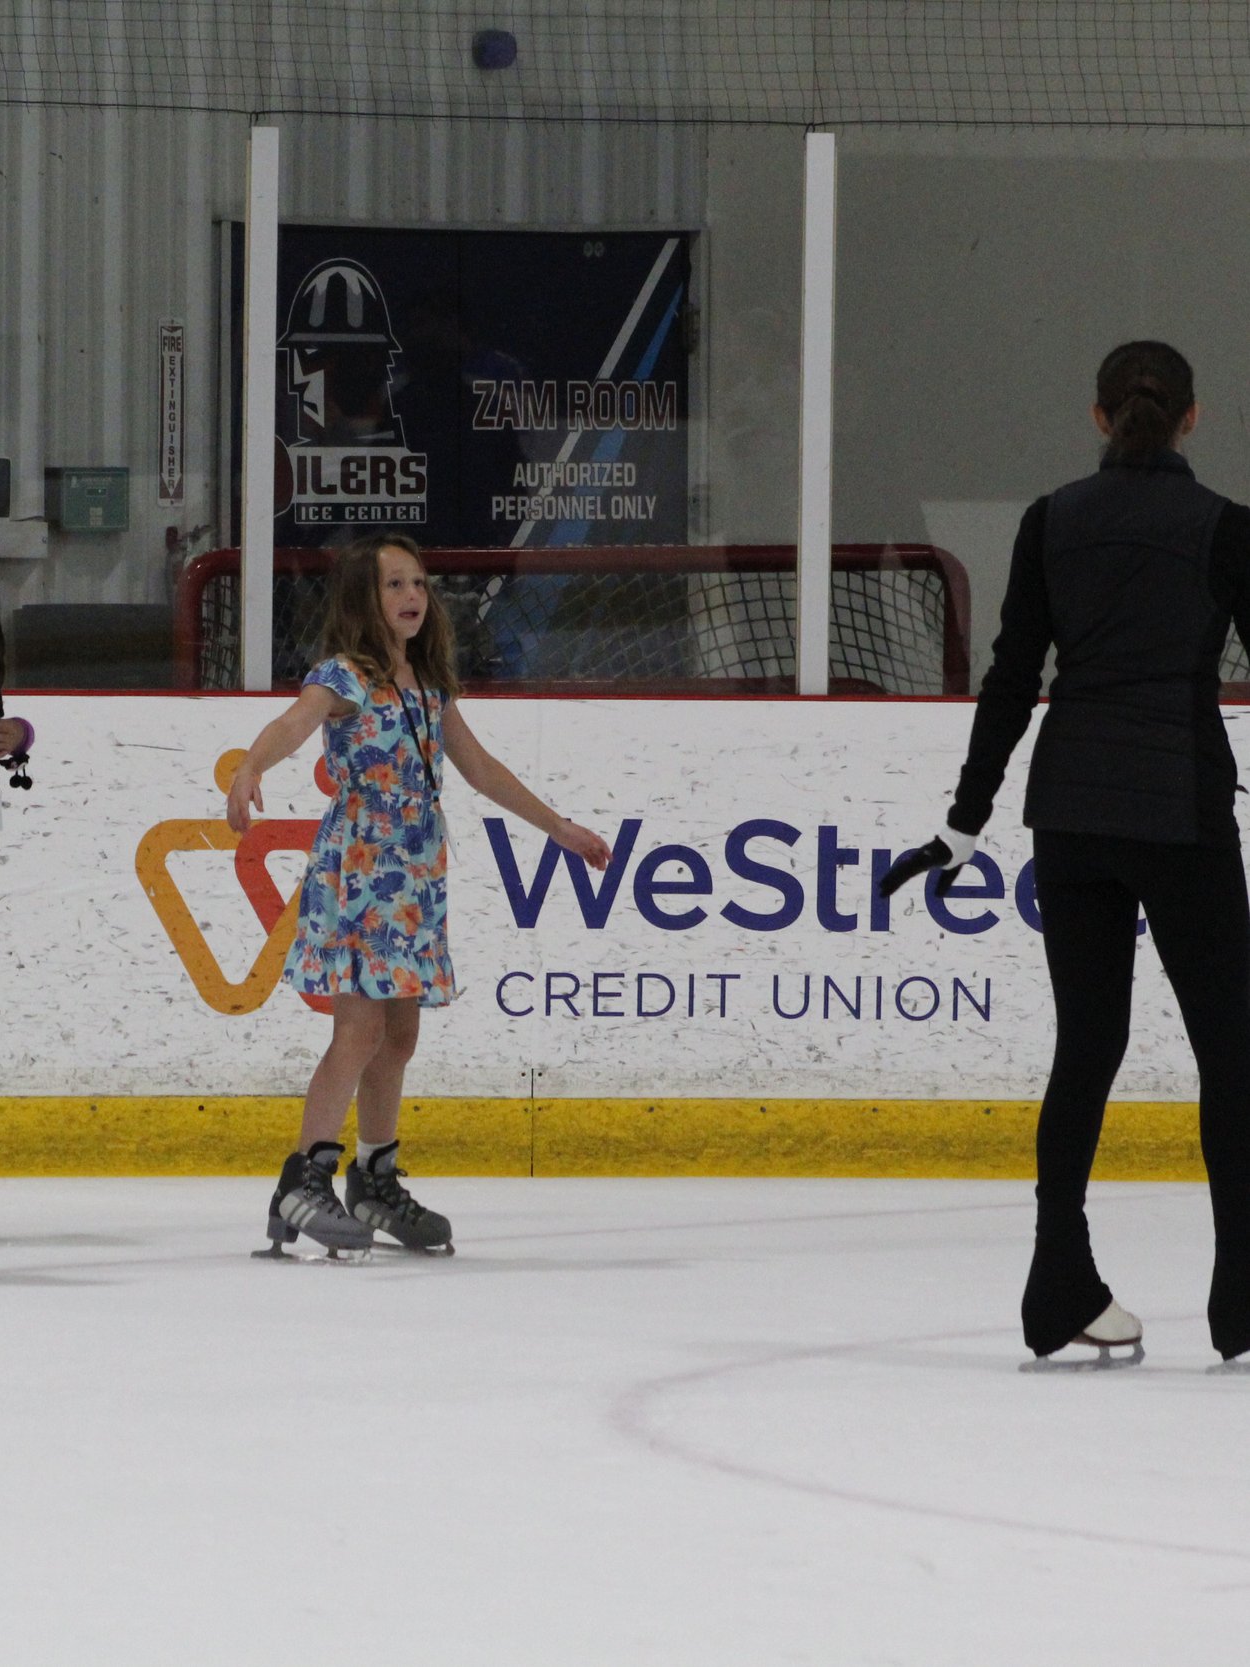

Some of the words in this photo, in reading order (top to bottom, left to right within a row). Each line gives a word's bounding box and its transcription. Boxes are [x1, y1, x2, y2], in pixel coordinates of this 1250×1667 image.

[162, 335, 182, 352] FIRE
[167, 355, 177, 489] EXTINGUISHER
[472, 380, 557, 430] ZAM
[567, 381, 677, 431] ROOM
[513, 462, 636, 488] AUTHORIZED
[300, 506, 333, 521] ICE
[344, 505, 421, 521] CENTER
[491, 496, 606, 520] PERSONNEL
[611, 496, 657, 520] ONLY
[482, 817, 1146, 936] WeStre
[495, 971, 741, 1019] CREDIT
[771, 974, 992, 1022] UNION
